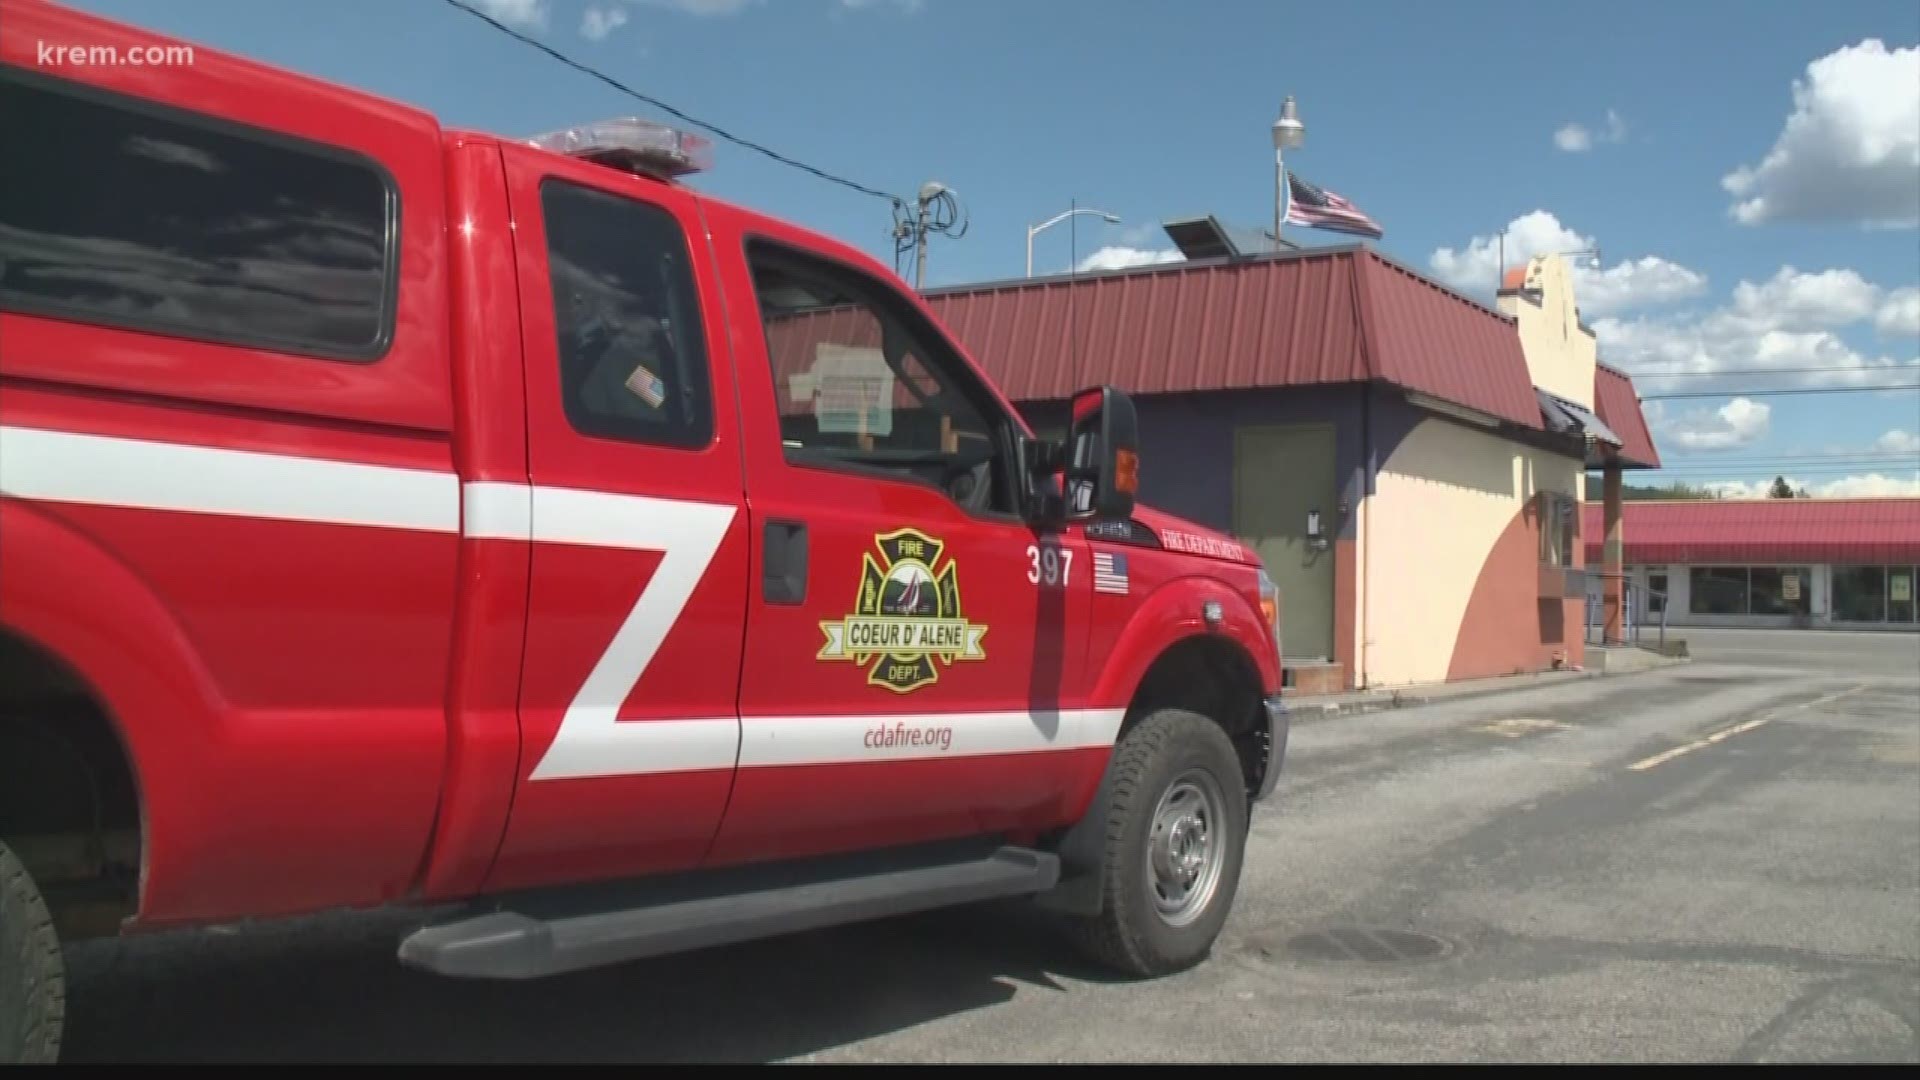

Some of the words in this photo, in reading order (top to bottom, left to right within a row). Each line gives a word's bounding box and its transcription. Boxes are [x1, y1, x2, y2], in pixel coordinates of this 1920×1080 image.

[897, 540, 924, 557] FIRE
[1160, 528, 1185, 551] FIRE
[1184, 533, 1245, 562] DEPARTMENT
[1026, 545, 1073, 588] 397
[850, 622, 900, 646] COEUR
[919, 625, 963, 647] ALENE
[888, 664, 920, 681] DEPT.
[863, 721, 953, 751] cdafire.org
